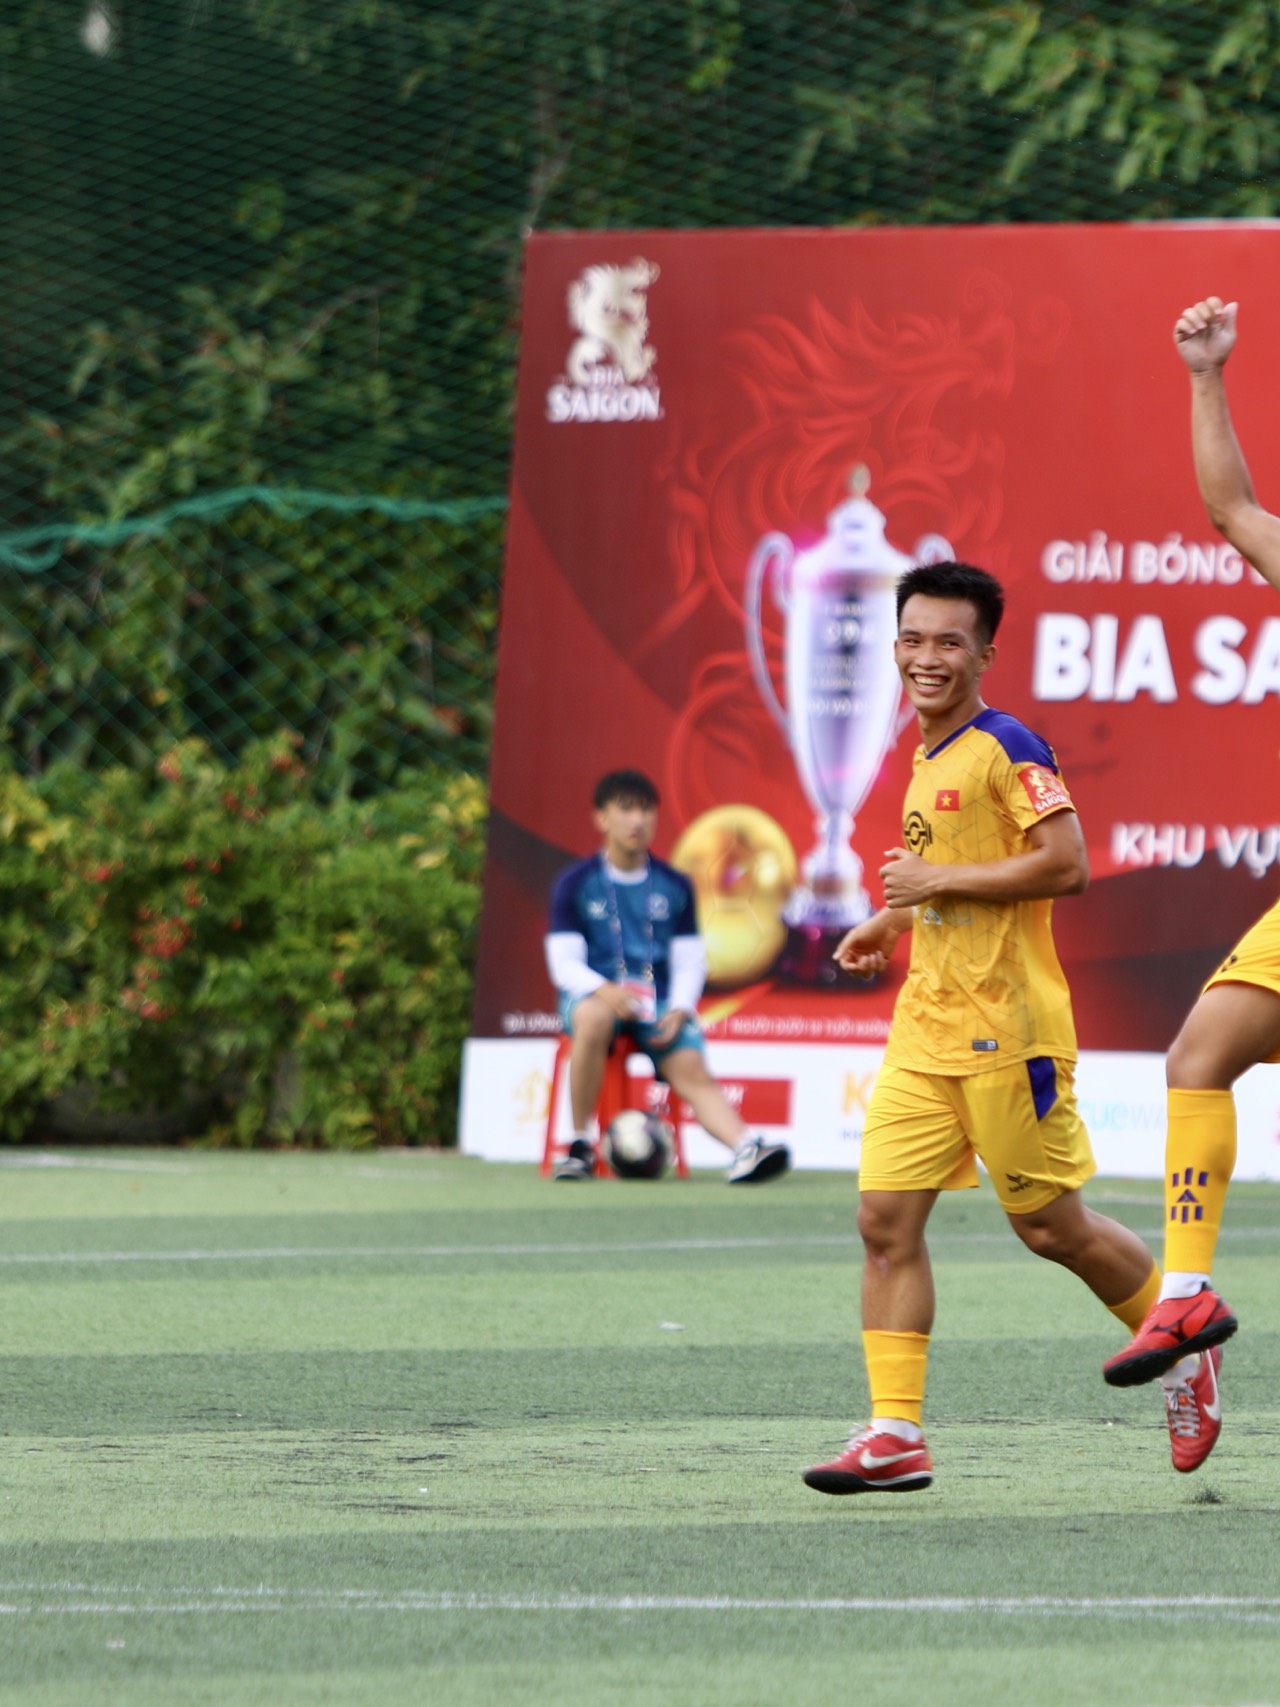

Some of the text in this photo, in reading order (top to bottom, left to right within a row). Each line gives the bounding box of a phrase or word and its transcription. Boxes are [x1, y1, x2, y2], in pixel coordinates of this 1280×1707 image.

[547, 384, 661, 422] SAIGON
[1042, 533, 1124, 583] GIẢI
[1129, 534, 1245, 585] BÓNG
[1033, 614, 1178, 701] BIA
[1111, 823, 1205, 868] KHU
